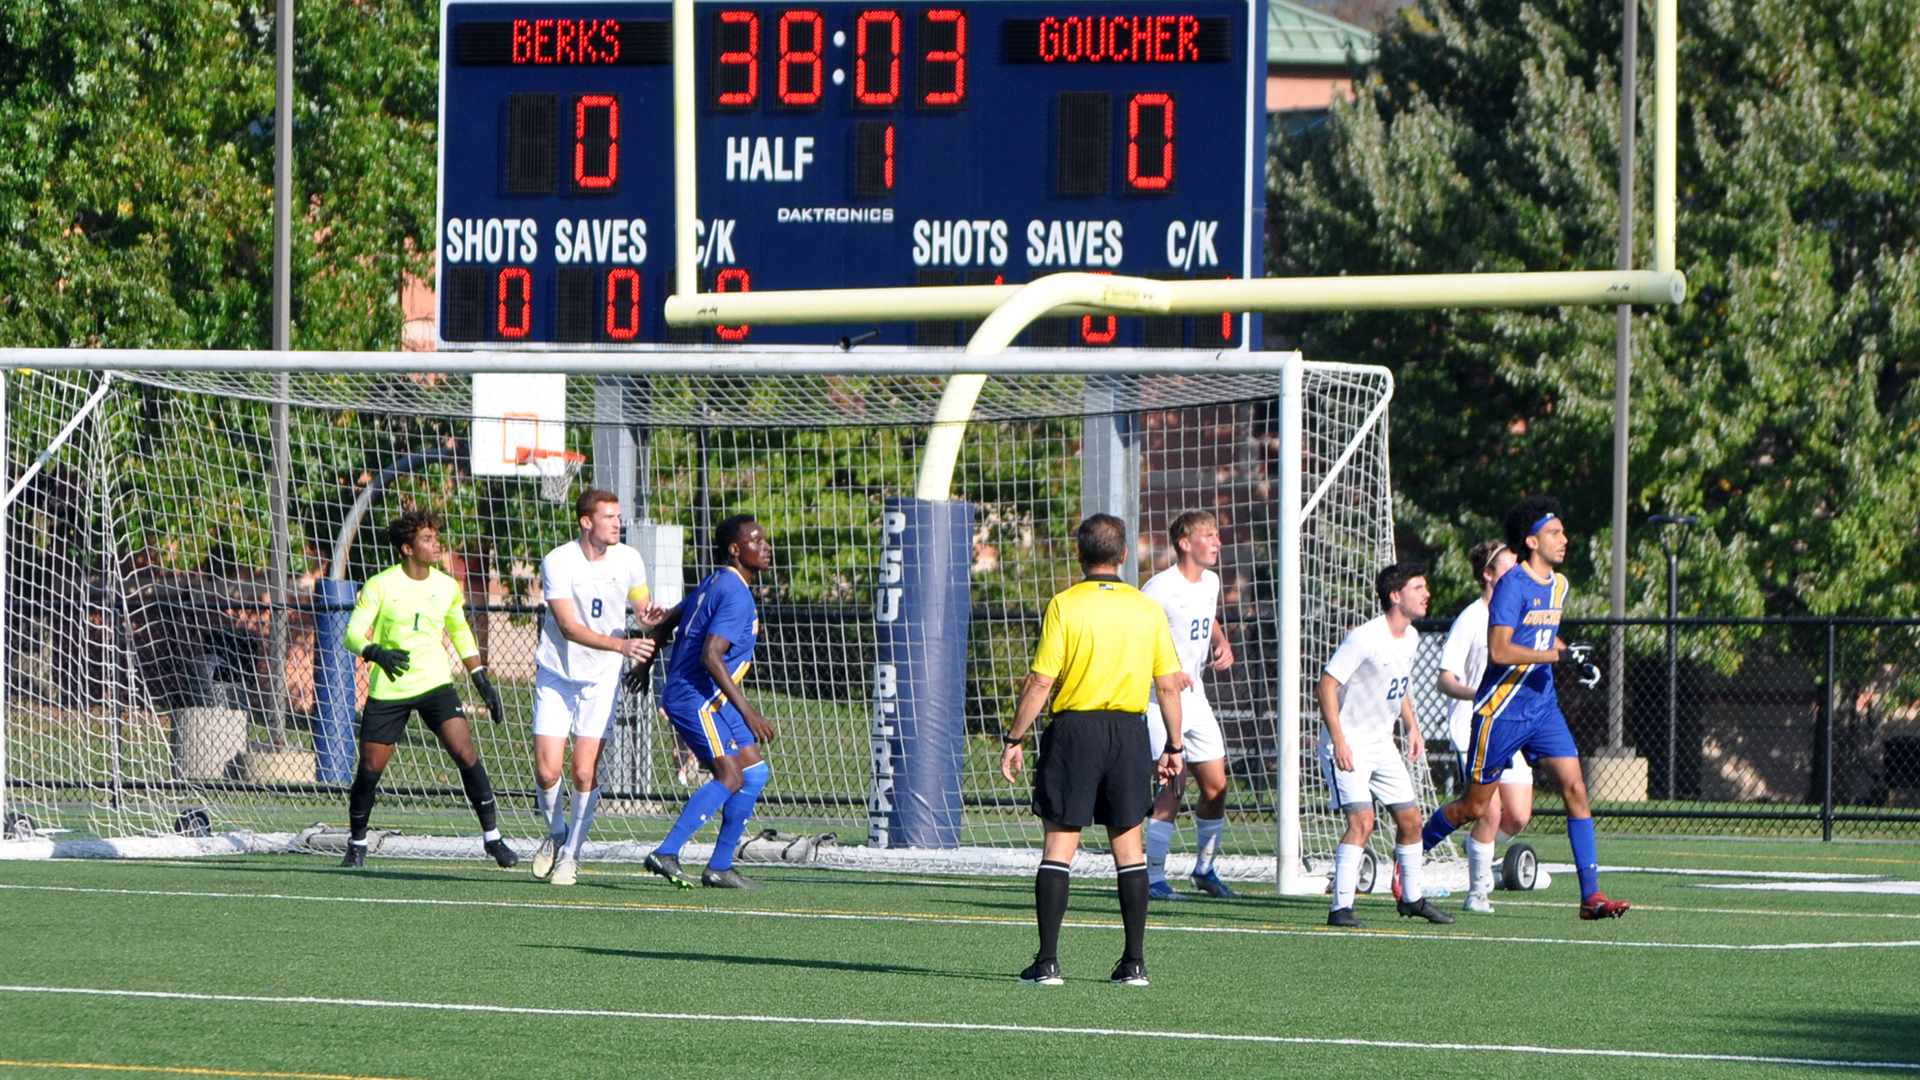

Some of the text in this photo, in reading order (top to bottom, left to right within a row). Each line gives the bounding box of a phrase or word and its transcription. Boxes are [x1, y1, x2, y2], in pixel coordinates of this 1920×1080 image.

[512, 18, 620, 63] BERKS
[718, 9, 966, 105] 38:03
[1039, 15, 1199, 62] GOUCHER
[574, 94, 619, 188] 0
[726, 125, 894, 188] HALF 1
[1127, 93, 1174, 189] 0
[777, 207, 895, 223] DAKTRONICS
[446, 217, 538, 263] SHOTS
[554, 218, 647, 263] SAVES
[912, 219, 1219, 271] SHOTS SAVES C/K
[497, 267, 532, 338] 0
[606, 268, 640, 339] 0
[591, 598, 602, 618] 8
[1190, 617, 1210, 640] 29
[868, 511, 906, 849] PSU BERKS
[1387, 676, 1409, 700] 23
